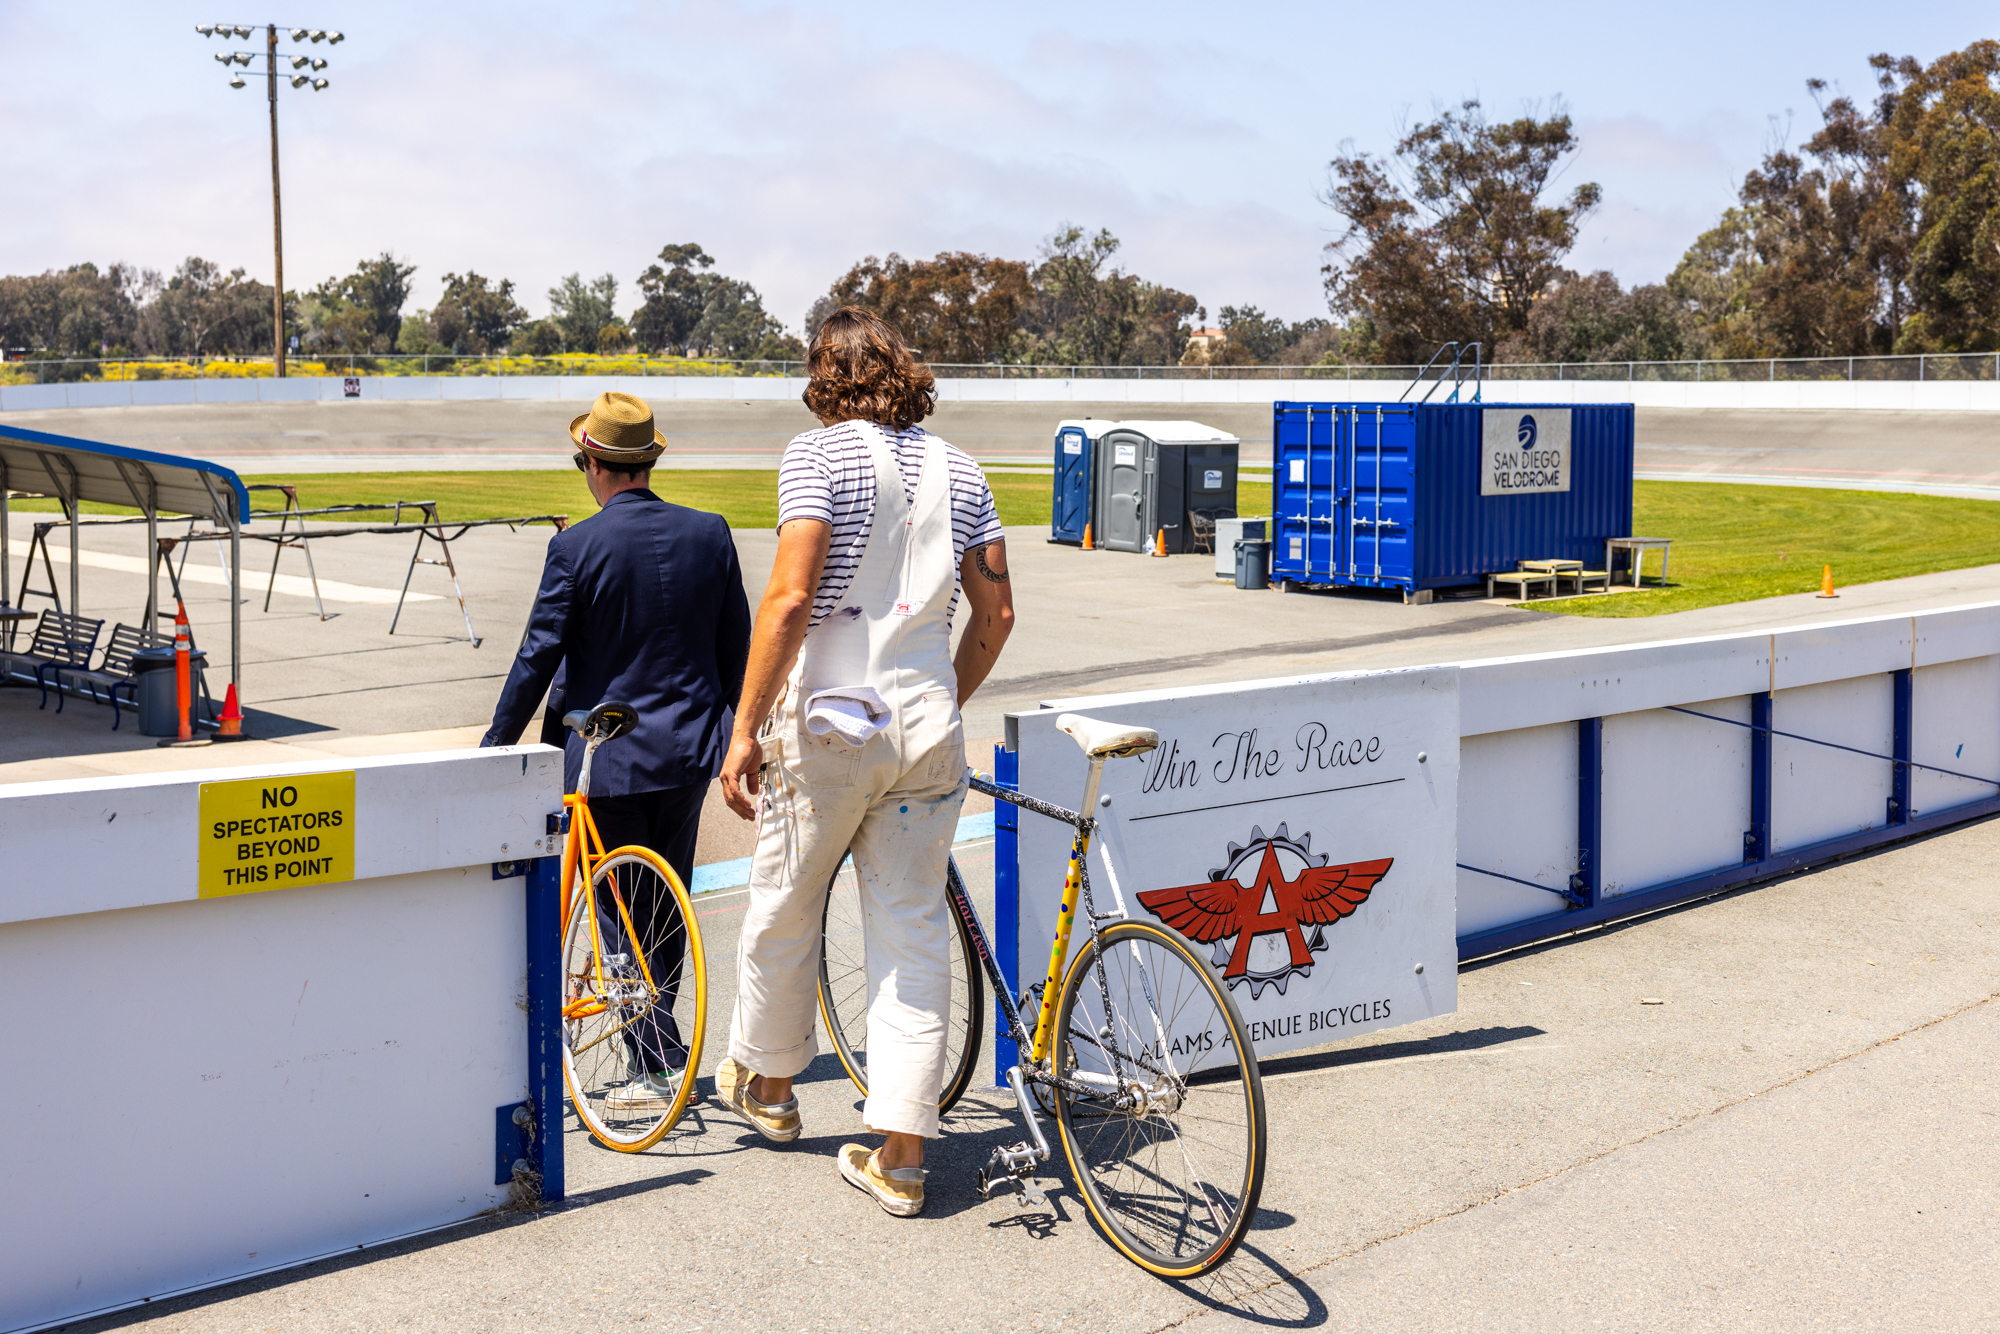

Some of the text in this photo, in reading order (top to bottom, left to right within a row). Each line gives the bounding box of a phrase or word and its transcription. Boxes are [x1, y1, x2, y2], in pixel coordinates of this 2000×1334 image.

[1494, 450, 1560, 470] SAN DIEGO
[1494, 470, 1559, 488] VELODROME
[1138, 721, 1385, 794] Win The Race
[262, 786, 298, 809] NO
[213, 810, 343, 839] SPECTATORS
[237, 836, 320, 860] BEYOND
[223, 857, 333, 886] THIS POINT
[955, 894, 988, 961] HOLLAND
[1222, 1014, 1302, 1047] AENUE
[1309, 998, 1391, 1032] BICYCLES
